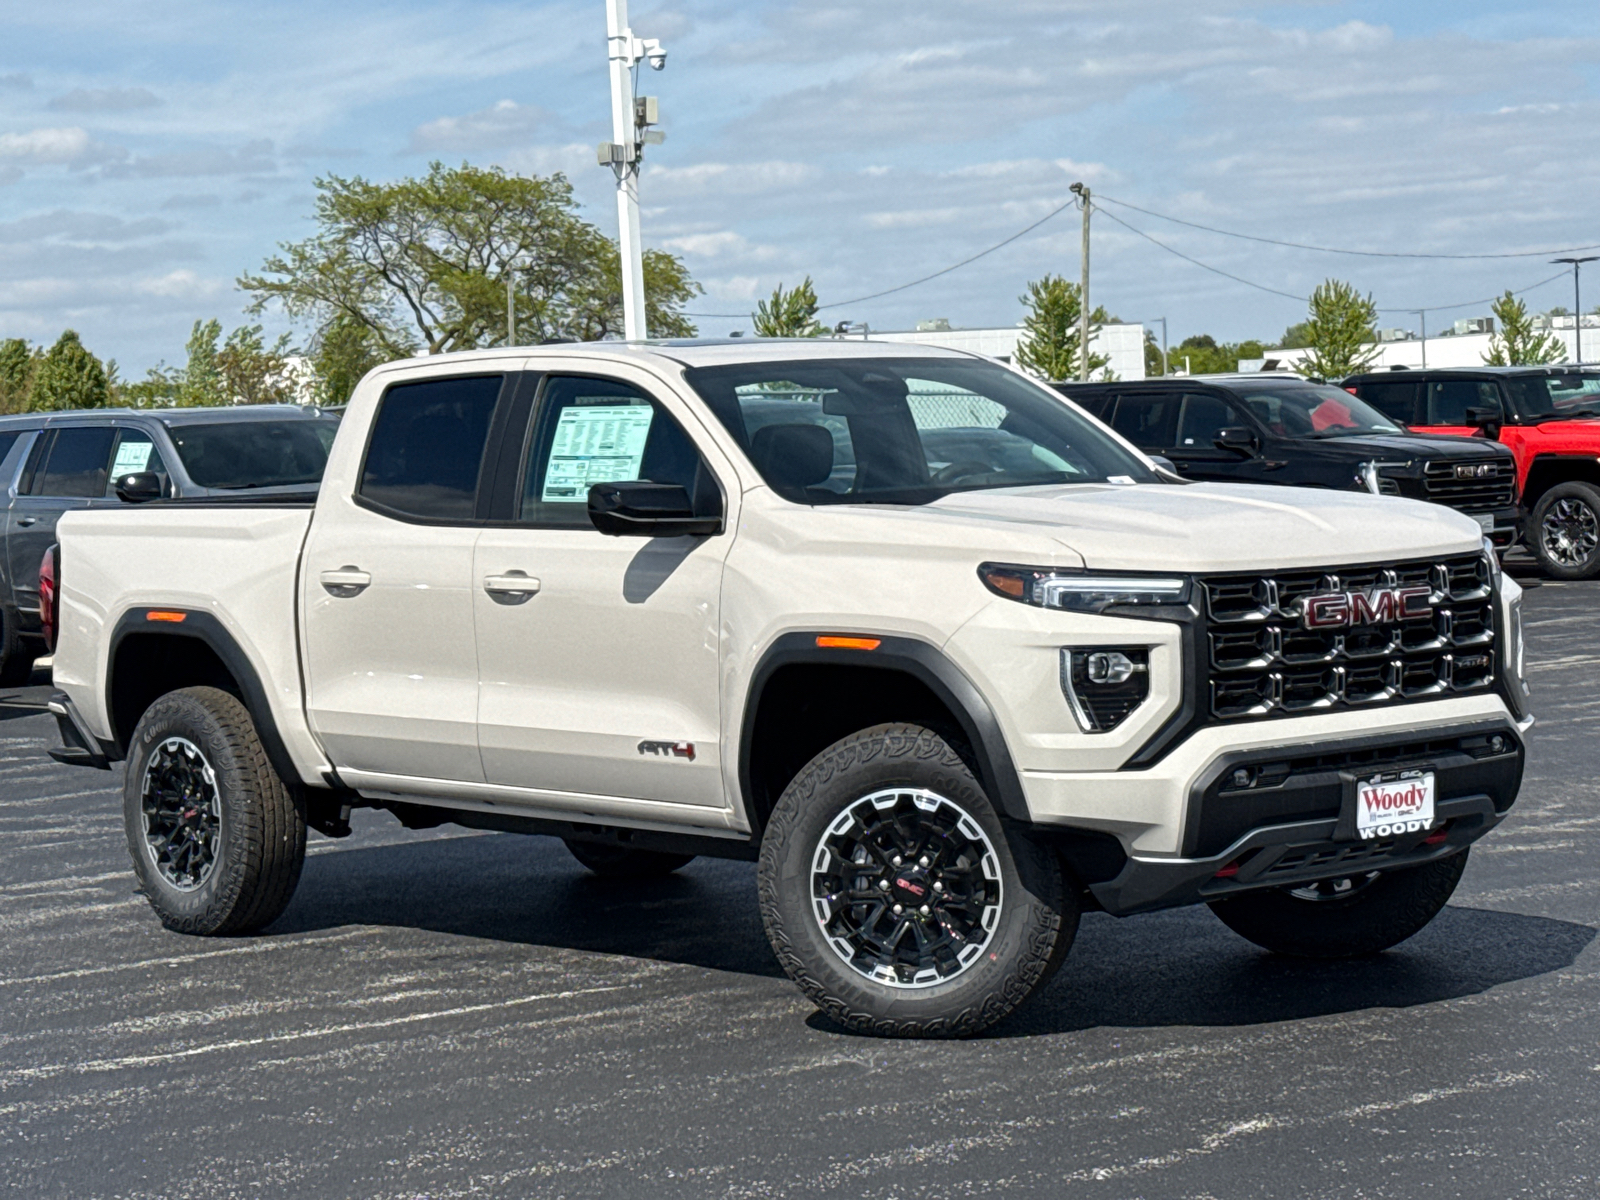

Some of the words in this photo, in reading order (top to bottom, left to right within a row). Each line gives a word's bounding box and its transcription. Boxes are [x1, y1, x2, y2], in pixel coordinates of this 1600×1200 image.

[1303, 586, 1433, 630] GMC
[637, 740, 696, 762] AT4
[1362, 784, 1428, 812] Woody
[1359, 819, 1433, 839] WOODY
[897, 878, 925, 896] GMC
